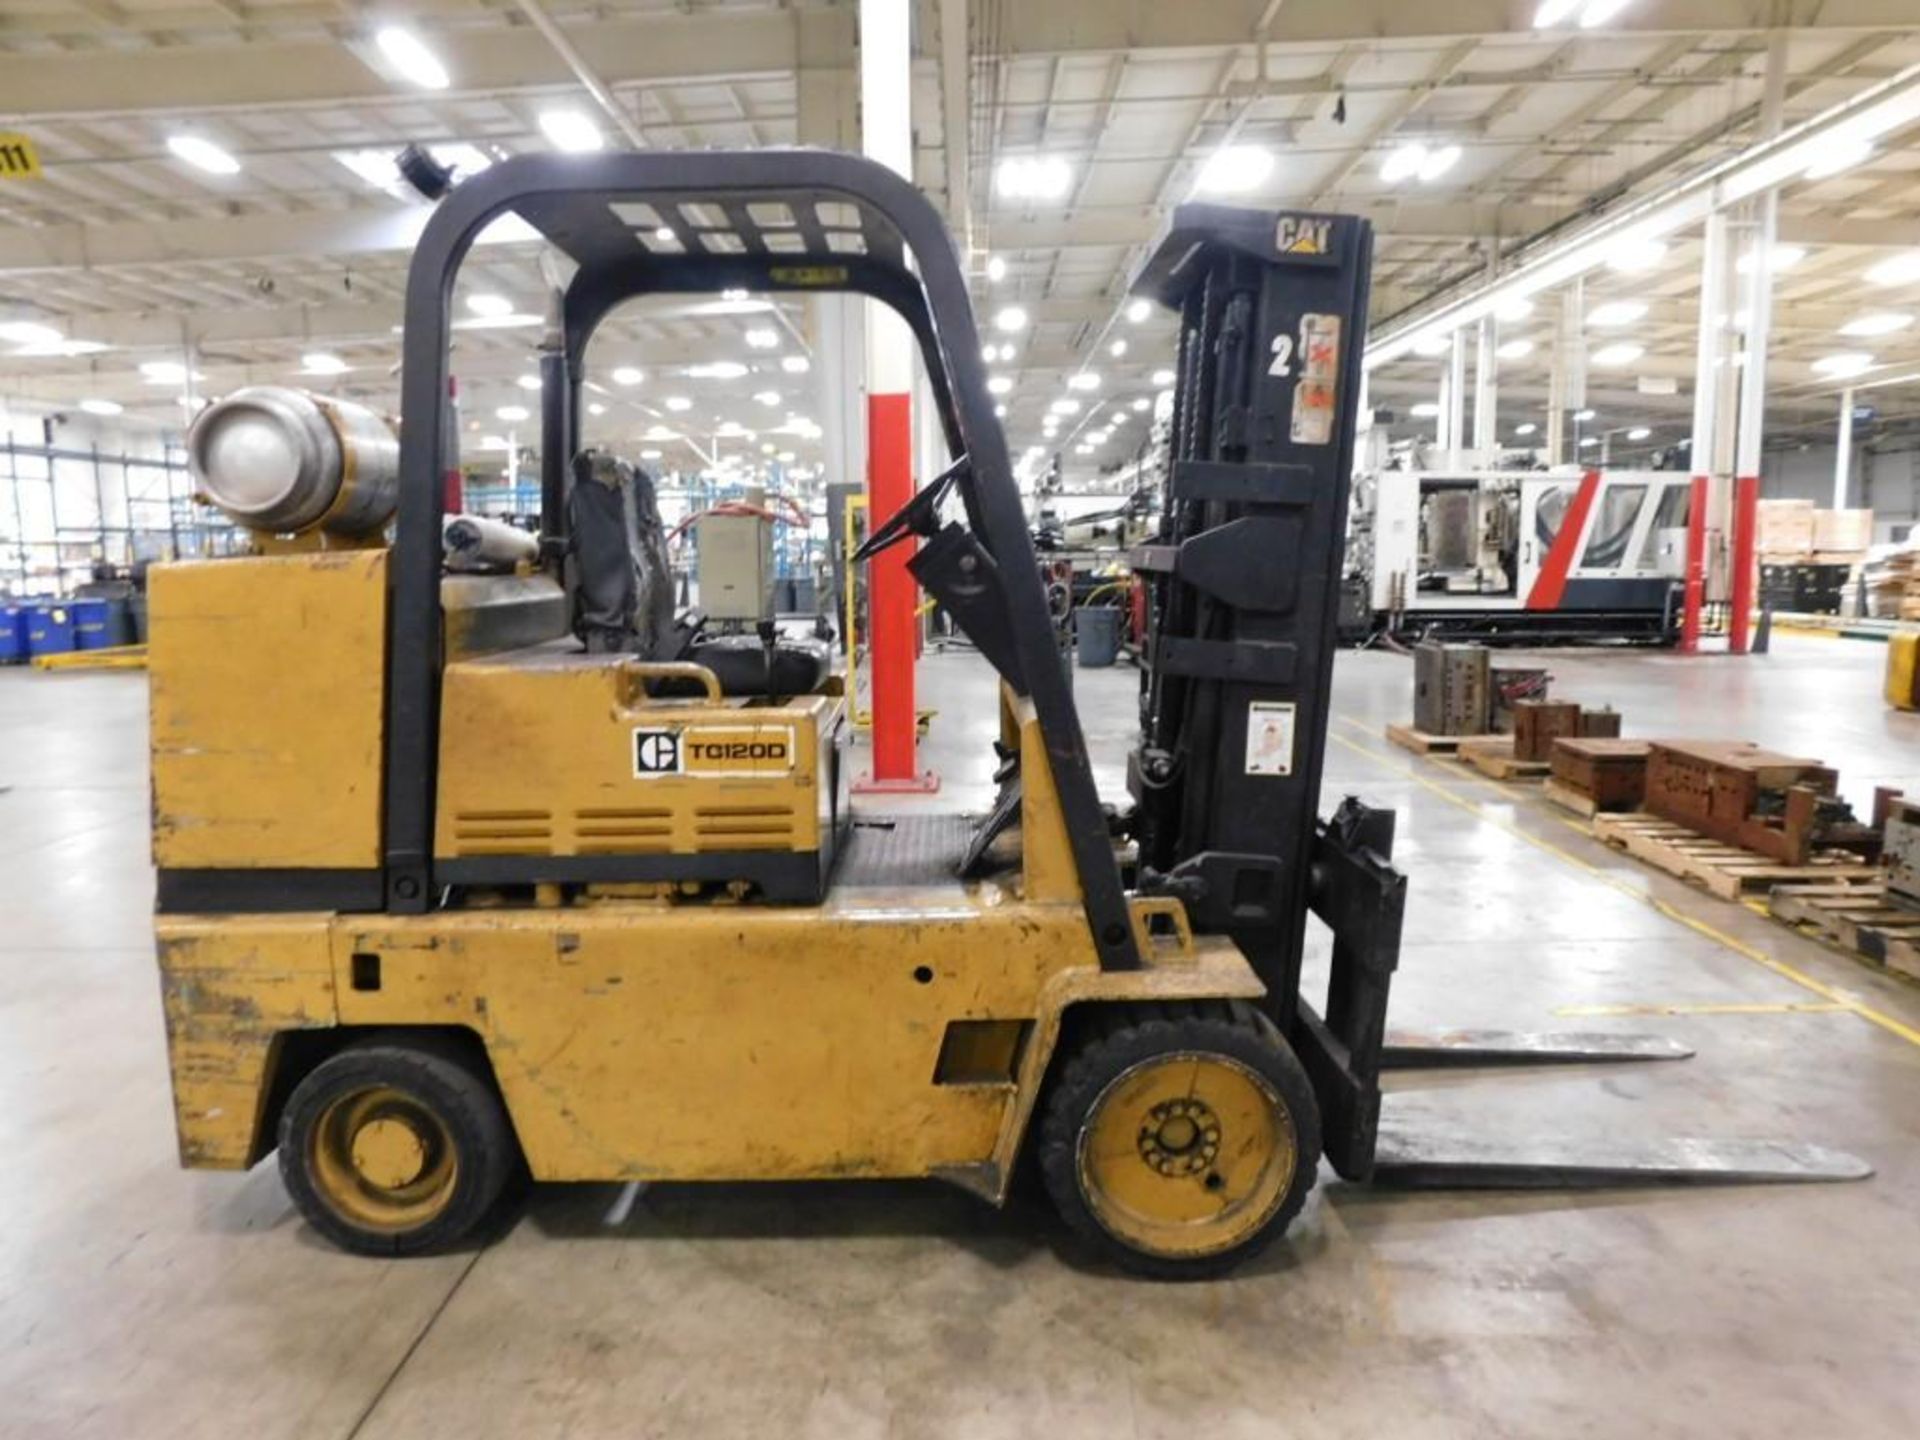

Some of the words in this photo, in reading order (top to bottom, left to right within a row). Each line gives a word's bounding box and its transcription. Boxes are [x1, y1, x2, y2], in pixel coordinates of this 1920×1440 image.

[0, 145, 30, 171] 11
[1276, 217, 1332, 254] CAT
[1268, 333, 1307, 378] 2
